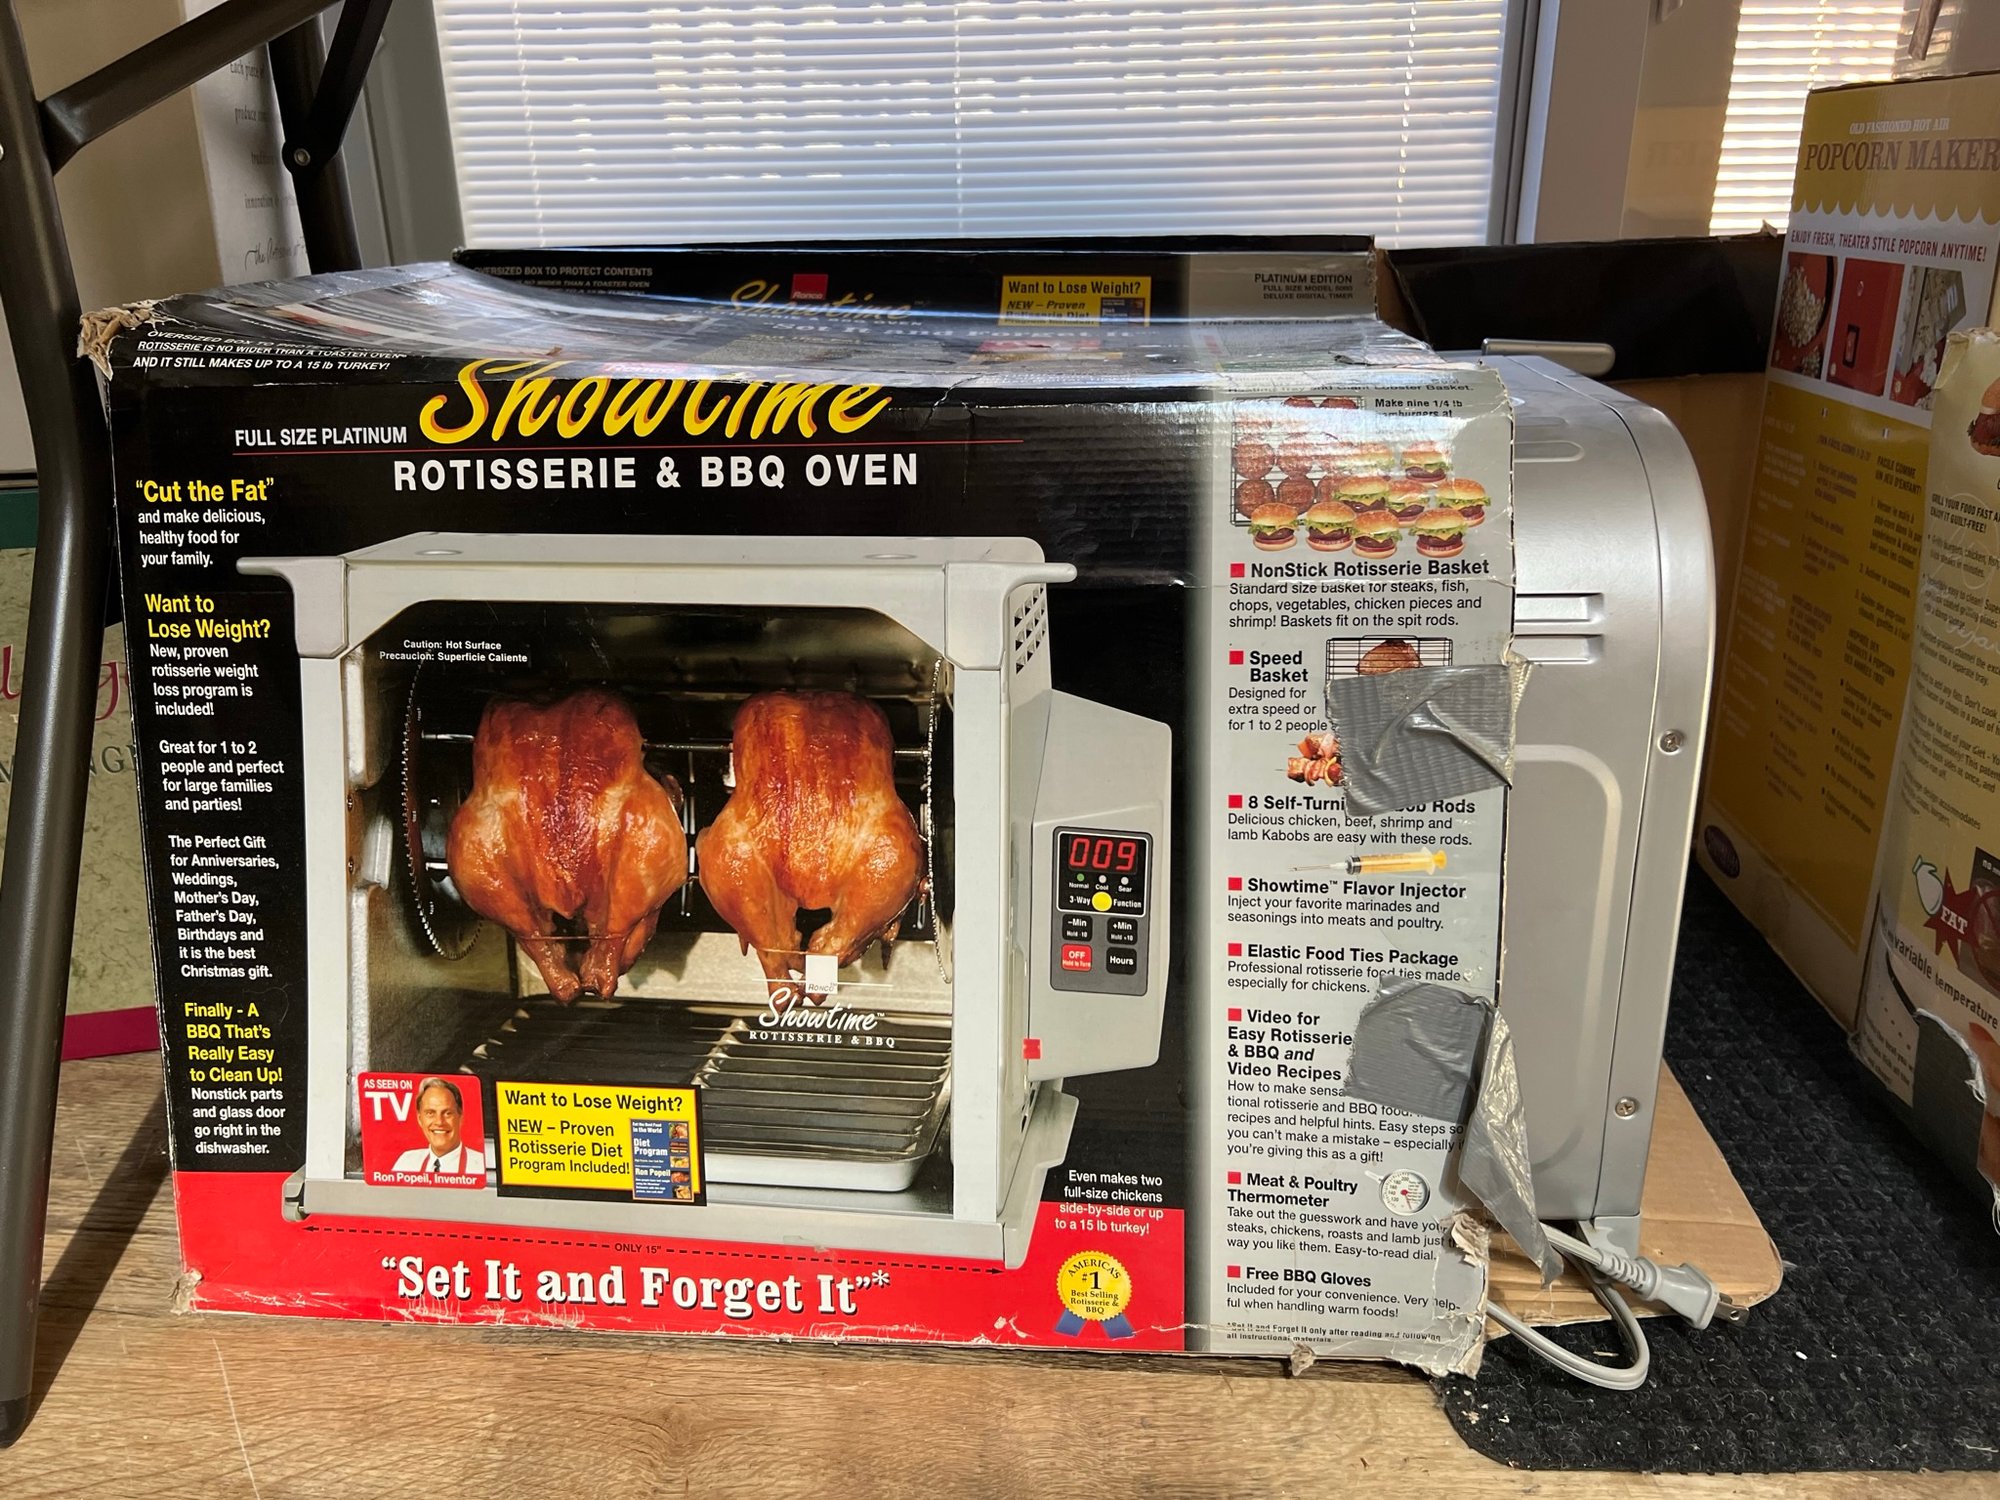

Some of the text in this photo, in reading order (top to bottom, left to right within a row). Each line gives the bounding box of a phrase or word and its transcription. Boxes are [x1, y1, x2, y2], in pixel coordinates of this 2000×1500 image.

[1913, 119, 1932, 132] HOT
[1932, 118, 1950, 131] AIR
[1804, 138, 2000, 171] POPCORN MAKER
[1791, 230, 1987, 262] ENJOY FRESH, THEATER STYLE POPCORN ANYTIME!
[524, 267, 543, 275] BOX
[546, 267, 558, 275] TO
[560, 267, 602, 276] PROTECT
[604, 268, 653, 276] CONTENTS
[1254, 273, 1352, 284] PLATINUM EDITION
[1008, 281, 1141, 296] Want to Lose Weight?
[132, 356, 158, 368] AND
[160, 357, 172, 368] IT
[173, 357, 206, 368] STILL
[208, 358, 253, 369] MAKES
[255, 359, 273, 369] UP
[276, 360, 293, 369] TO
[293, 360, 303, 369] A
[306, 360, 320, 370] 15
[336, 361, 391, 371] TURKEY!
[419, 358, 893, 445] Showtime
[234, 426, 408, 447] FULL SIZE PLATINUM
[393, 453, 918, 491] ROTISSERIE & BBQ OVEN
[188, 480, 224, 501] the
[1945, 497, 1959, 510] YOUR
[1960, 501, 1976, 515] FOOD
[1976, 507, 1993, 521] FAST
[1950, 513, 1987, 534] GUILT-FREE!
[1250, 559, 1490, 578] NonStick Rotisserie Basket
[144, 593, 215, 613] Want to
[147, 618, 271, 643] Lose Weight?
[403, 639, 502, 650] Caution: Hot Surface
[437, 652, 486, 663] Superficie
[488, 653, 528, 662] Caliente
[1249, 650, 1303, 668] Speed
[1249, 668, 1309, 683] Basket
[1068, 837, 1137, 871] 009
[1069, 881, 1132, 893] Normal Cool Sear
[1343, 881, 1395, 896] Flavor
[1399, 882, 1467, 899] Injector
[1069, 895, 1142, 908] 3-Way Function
[1940, 905, 1968, 935] FAT
[1068, 950, 1134, 965] OFF Hours
[1894, 935, 1999, 1030] variable temperature
[184, 1002, 232, 1020] Finally
[247, 1002, 259, 1018] A
[759, 987, 878, 1031] Showtime
[186, 1024, 271, 1039] BBQ That’s
[749, 1030, 895, 1048] ROTISSERIE & BBQ
[188, 1045, 274, 1063] Really Easy
[189, 1067, 283, 1085] to Clean Up!
[363, 1078, 413, 1090] AS SEEN ON
[363, 1091, 413, 1122] TV
[504, 1090, 684, 1114] Want to Lose Weight?
[507, 1119, 543, 1136] NEW
[560, 1122, 614, 1137] Proven
[508, 1138, 623, 1158] Rotisserie Diet
[634, 1138, 650, 1147] Diet
[634, 1147, 668, 1157] Program
[509, 1157, 566, 1173] Program
[569, 1159, 631, 1175] Included!
[373, 1171, 478, 1185] Ron Popeil, Inventor
[1068, 1170, 1163, 1186] Even makes two
[1246, 1173, 1359, 1196] Meat & Poultry
[1064, 1186, 1163, 1202] full-size chickens
[1227, 1189, 1330, 1208] Thermometer
[1060, 1203, 1164, 1220] side-by-side or up
[1054, 1218, 1150, 1237] to a 15 lb turkey!
[614, 1243, 643, 1253] ONLY
[1246, 1267, 1372, 1287] Free BBQ Gloves
[484, 1259, 522, 1302] It
[537, 1265, 627, 1307] and
[639, 1266, 804, 1319] Forget
[1071, 1289, 1119, 1300] Best Selling
[1070, 1297, 1110, 1307] Rotisserie
[1085, 1306, 1105, 1314] BBQ
